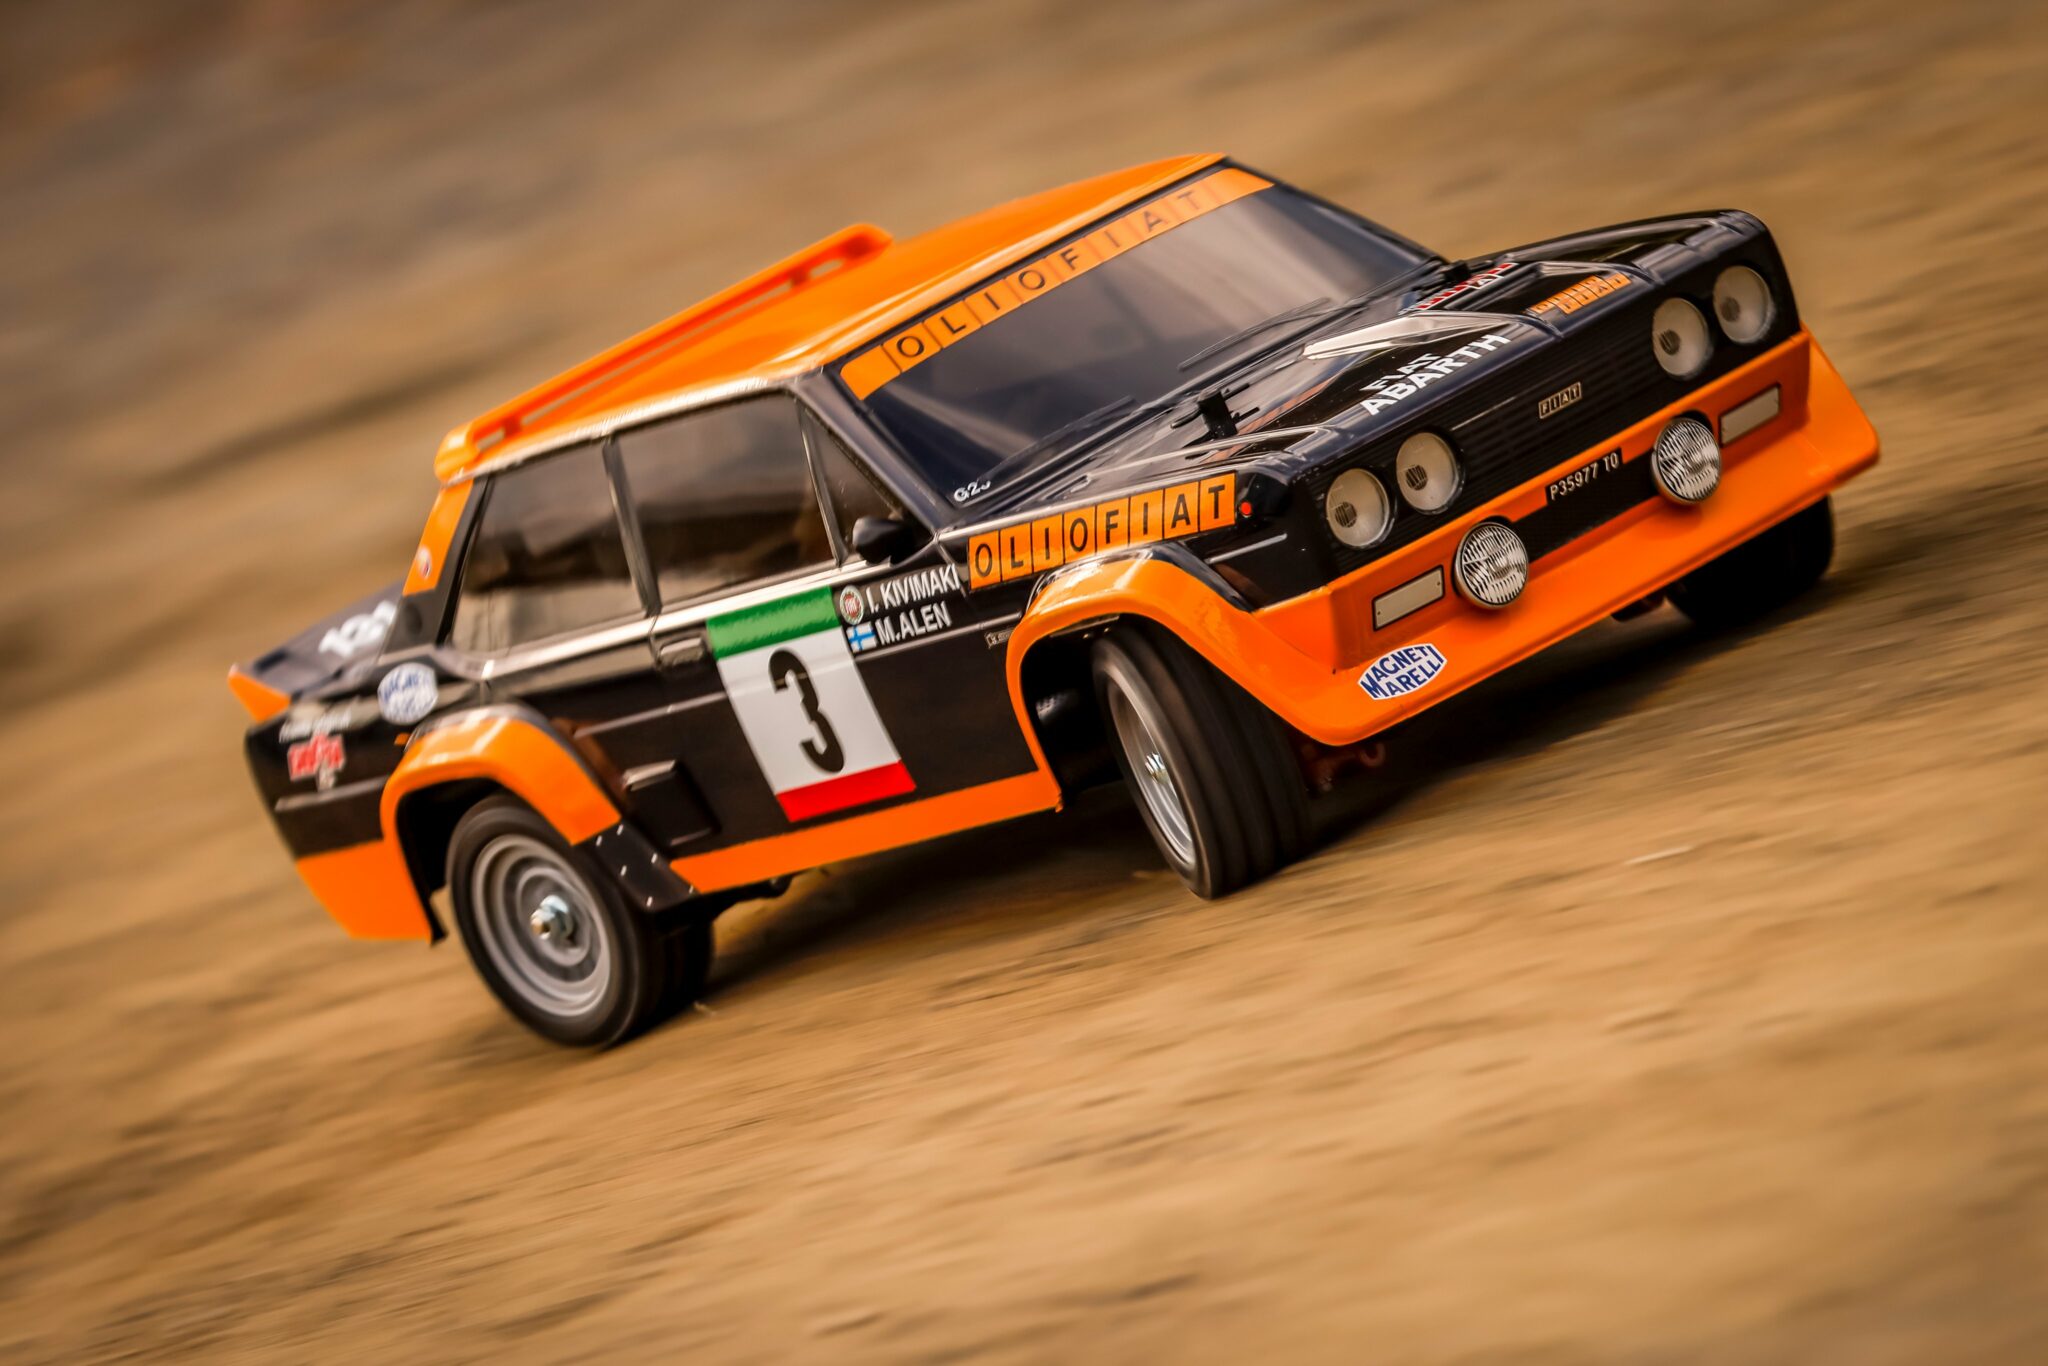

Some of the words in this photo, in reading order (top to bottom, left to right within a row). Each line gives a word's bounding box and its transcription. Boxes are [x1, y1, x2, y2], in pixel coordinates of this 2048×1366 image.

[1360, 353, 1442, 391] FIAT
[1360, 334, 1512, 416] ABARTH
[1541, 384, 1581, 415] FIAT
[1549, 461, 1599, 501] P35977
[974, 483, 1226, 578] OLIOFIAT
[879, 562, 961, 610] KIVIMAKI
[1360, 645, 1445, 699] MAGNETI
[768, 648, 845, 775] 3
